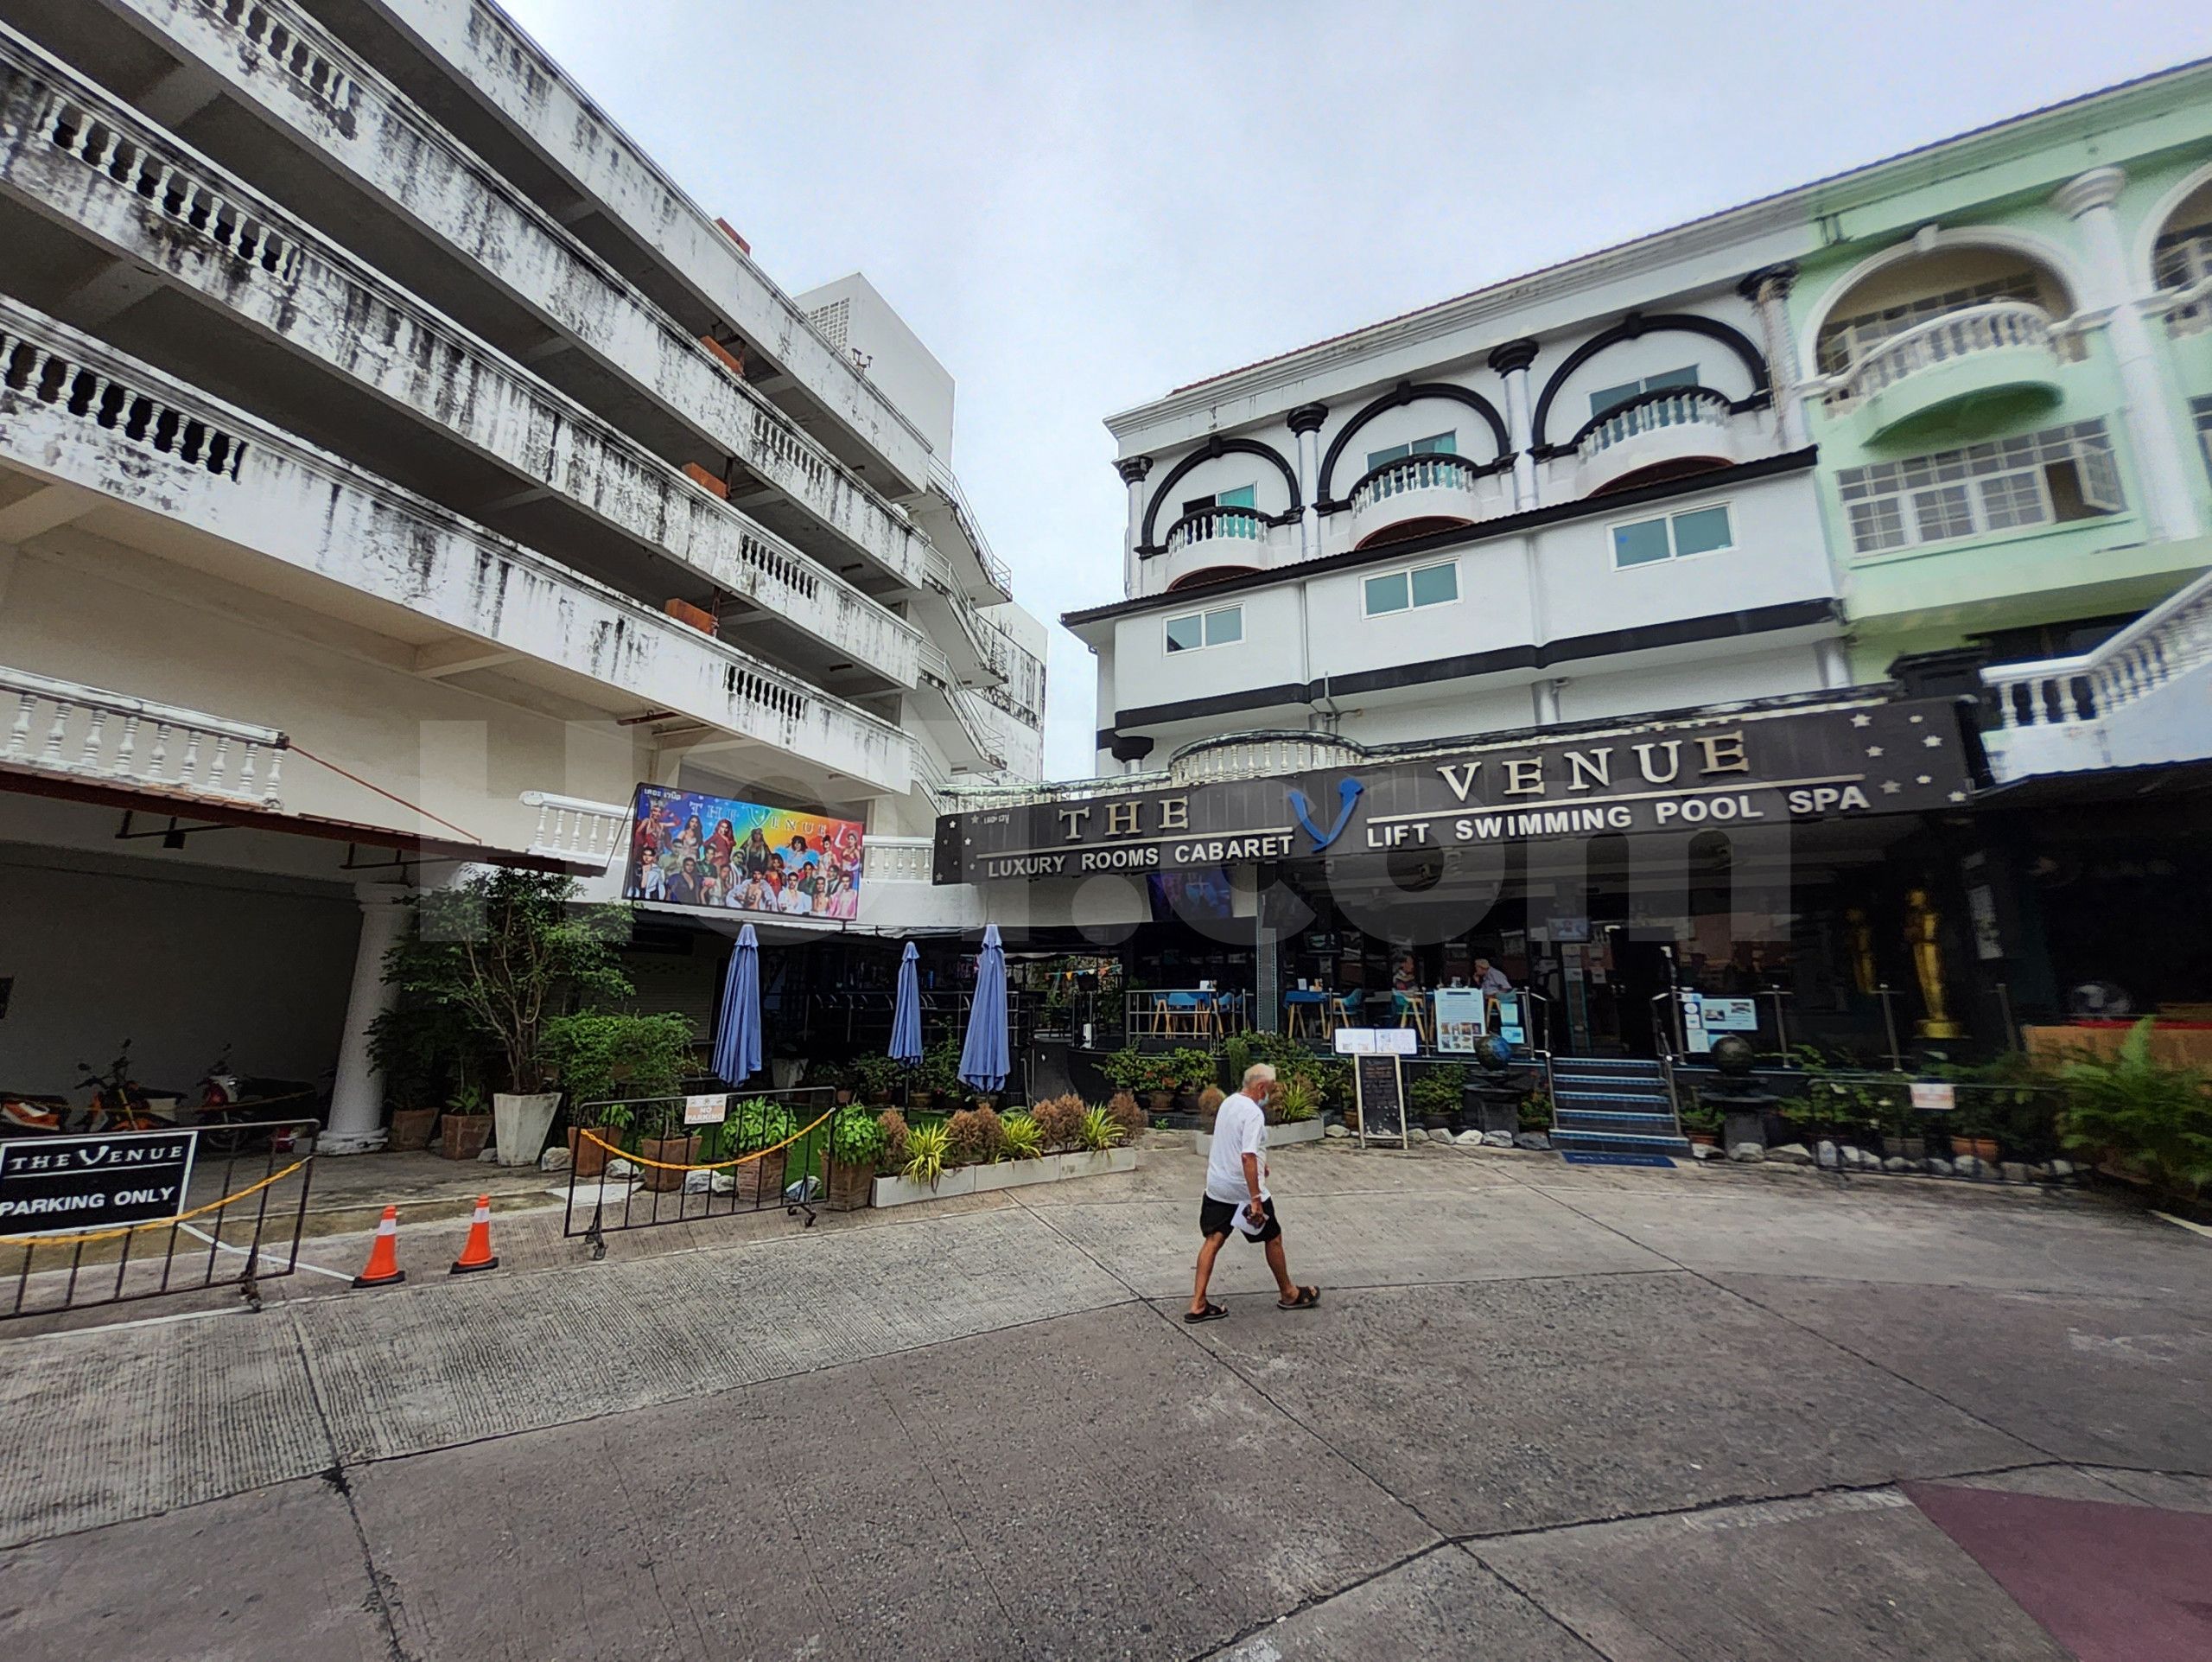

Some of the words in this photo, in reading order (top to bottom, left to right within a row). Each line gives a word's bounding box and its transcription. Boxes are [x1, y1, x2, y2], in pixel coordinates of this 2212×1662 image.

[1058, 796, 1188, 840] THE
[1436, 729, 1750, 802] VENUE
[1366, 823, 1430, 848] LIFT
[1455, 806, 1632, 840] SWIMMING
[1656, 795, 1764, 825] POOL
[1789, 786, 1871, 814] SPA
[988, 855, 1066, 878] LUXURY
[1081, 846, 1160, 871] ROOMS
[1173, 835, 1294, 863] CABARET
[7, 1153, 72, 1171] THE
[79, 1145, 183, 1166] VENUE
[0, 1193, 105, 1217] PARKING
[114, 1186, 175, 1206] ONLY
